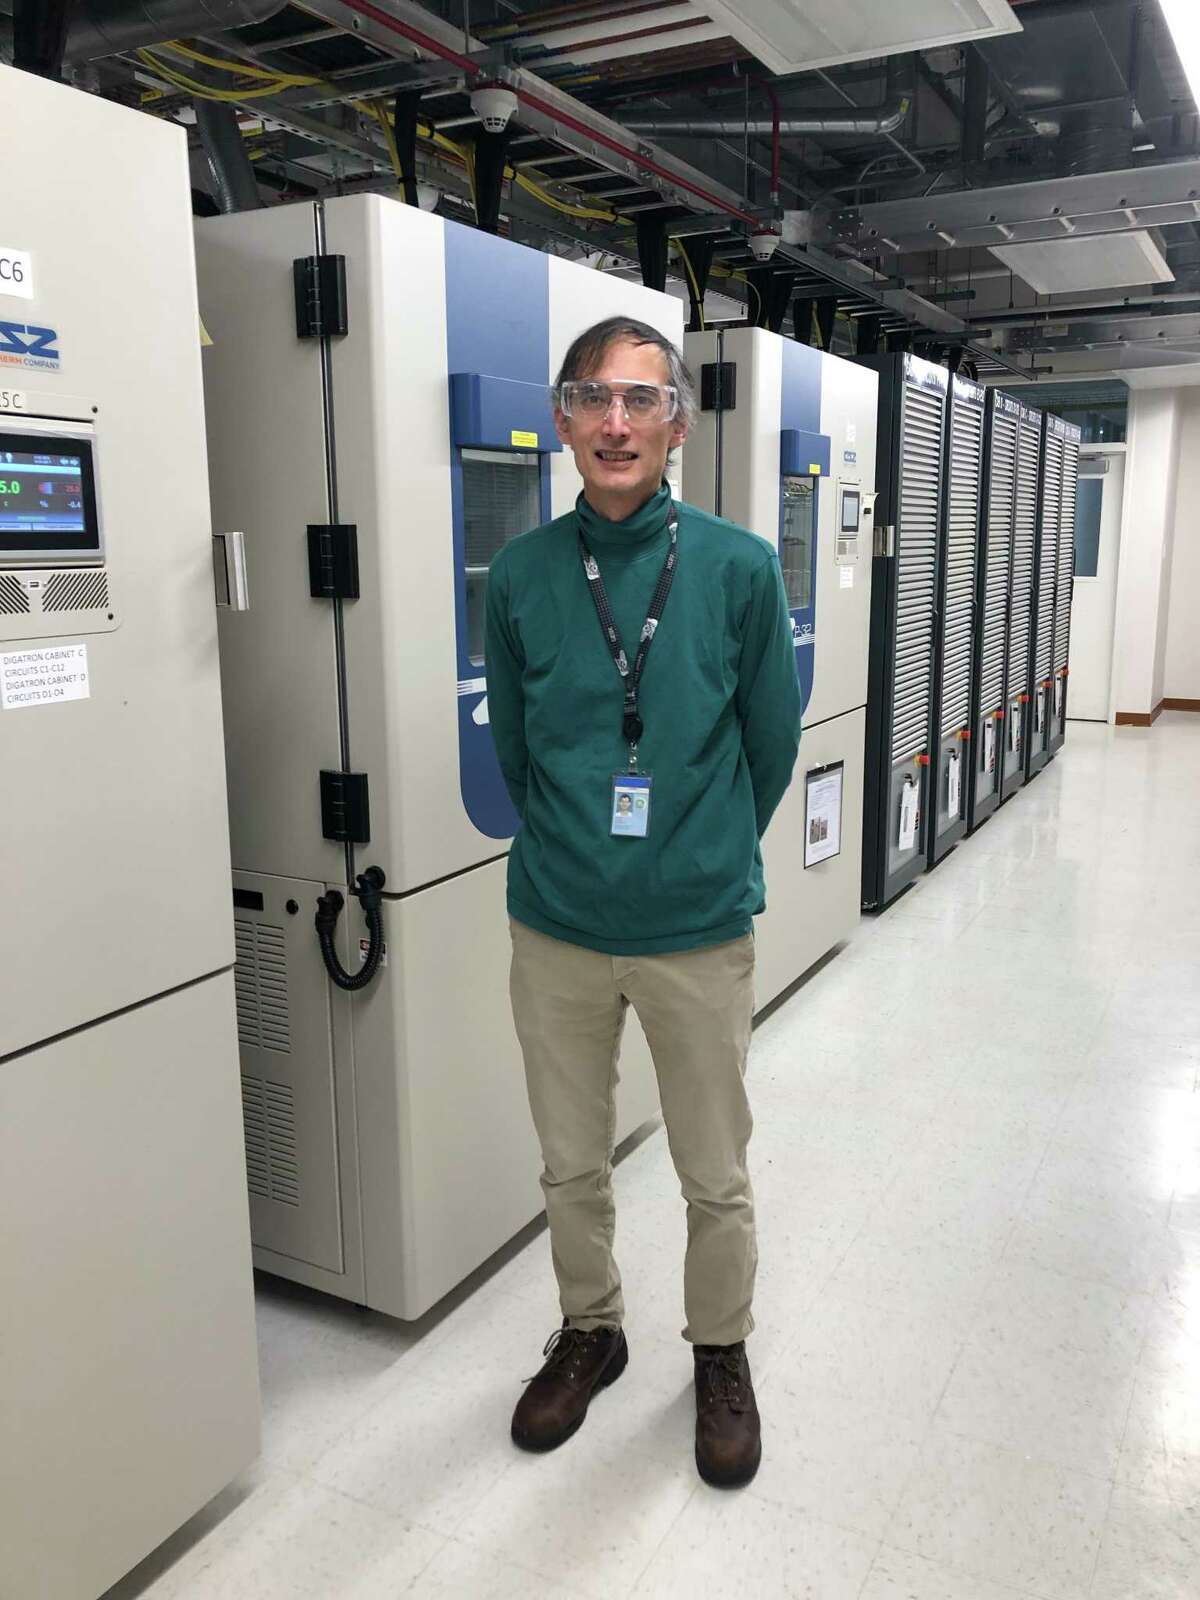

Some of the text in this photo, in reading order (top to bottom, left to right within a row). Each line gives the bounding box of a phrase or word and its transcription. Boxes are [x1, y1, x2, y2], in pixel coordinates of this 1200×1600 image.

[0, 258, 24, 282] C6
[23, 358, 59, 369] COMPANY
[3, 653, 44, 665] DIGATRON
[45, 649, 75, 661] CABINET
[5, 665, 39, 678] CIRCUITS
[6, 678, 46, 690] DIGATRON
[47, 674, 77, 686] CABINET
[7, 691, 41, 703] CIRCUITS
